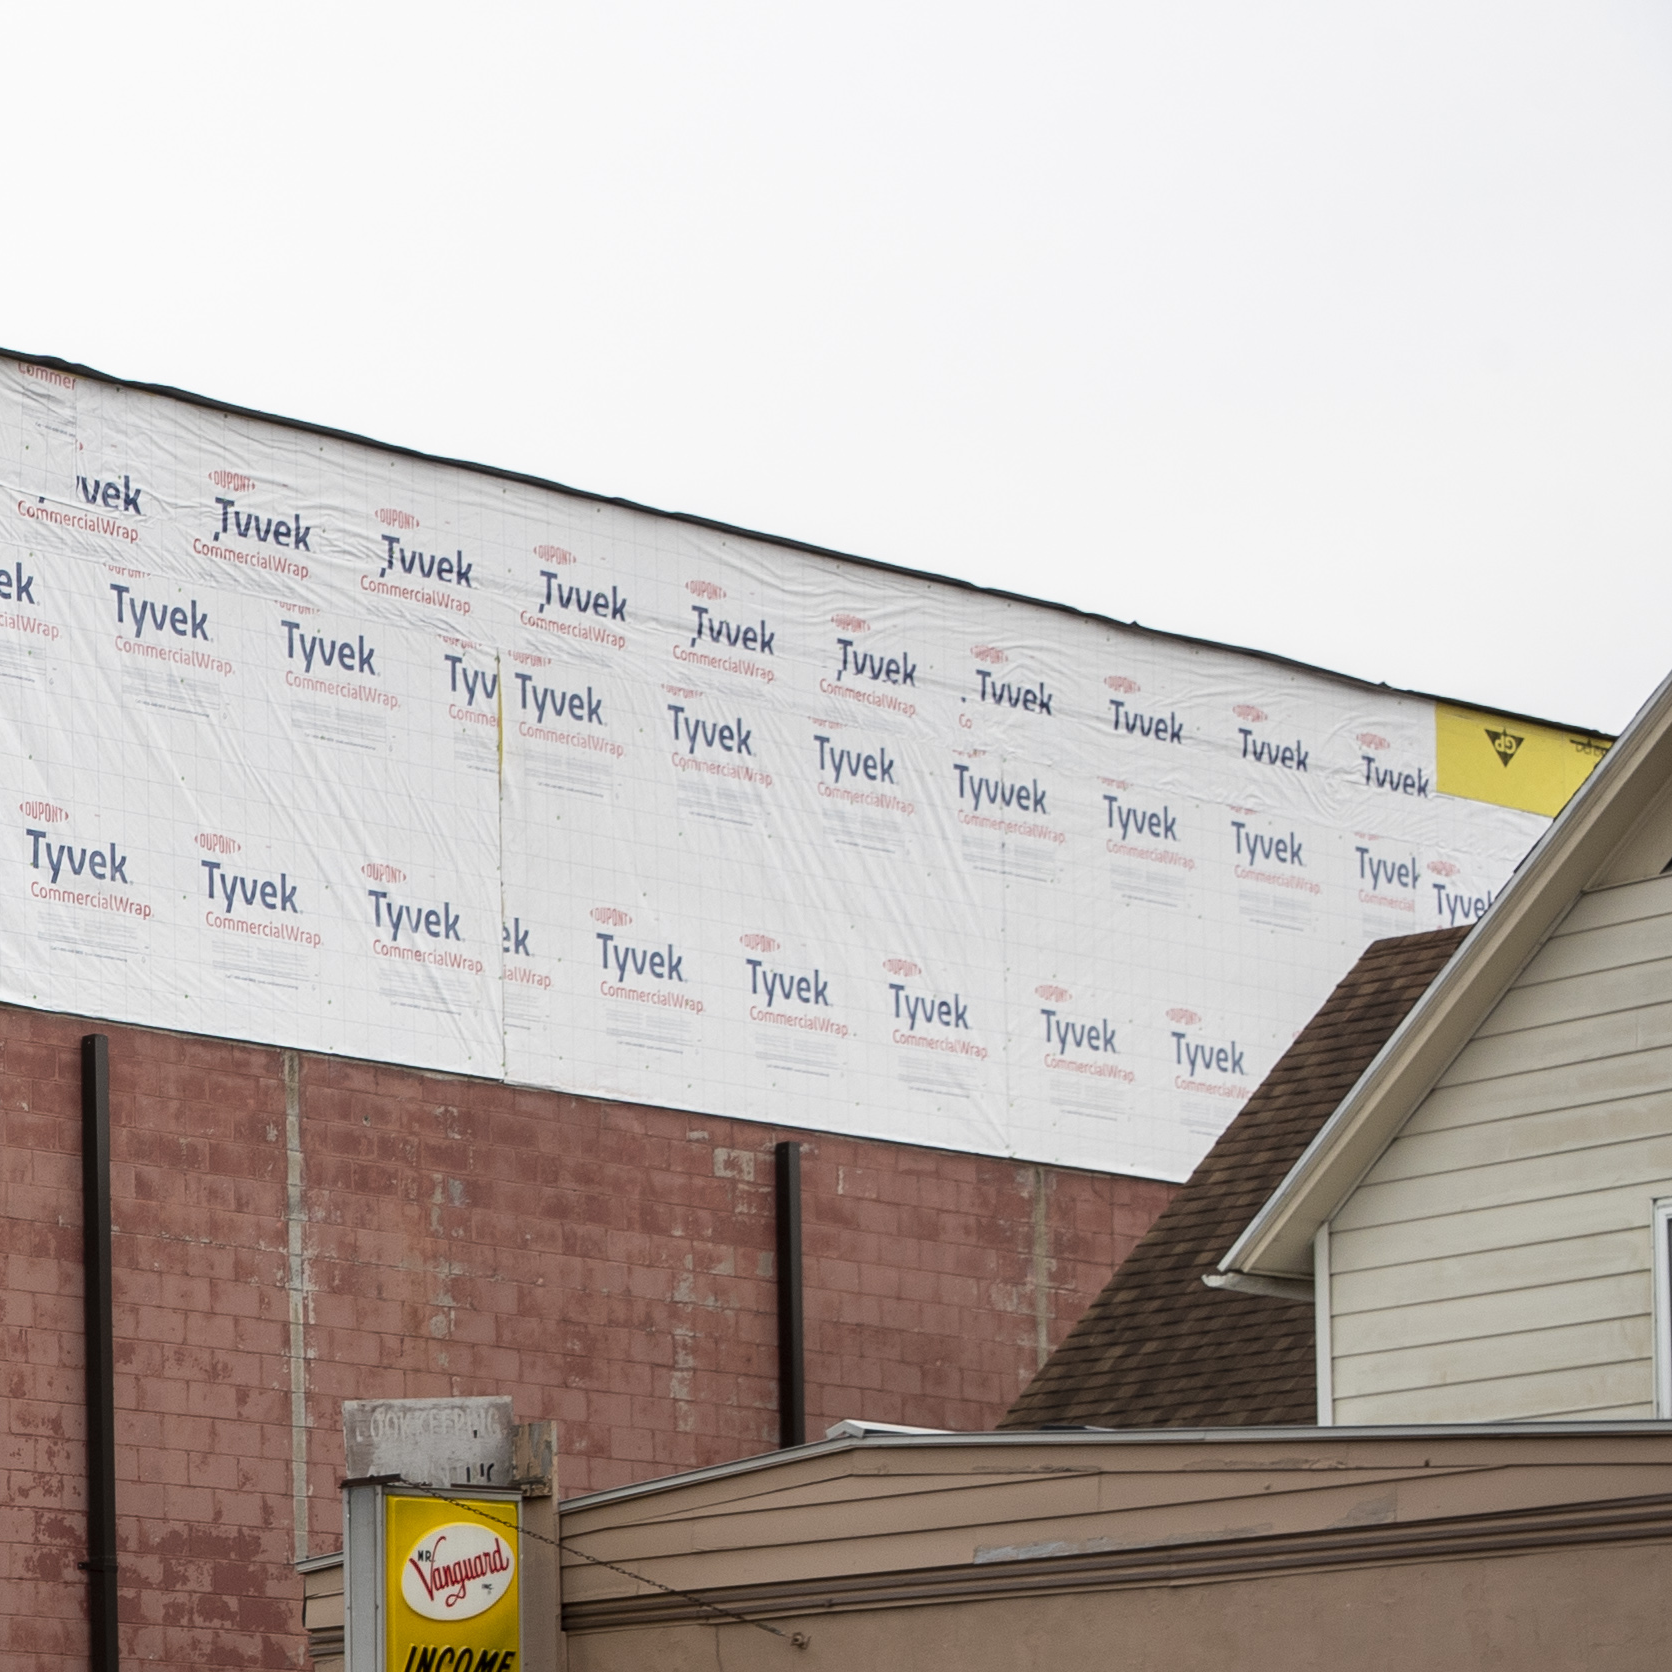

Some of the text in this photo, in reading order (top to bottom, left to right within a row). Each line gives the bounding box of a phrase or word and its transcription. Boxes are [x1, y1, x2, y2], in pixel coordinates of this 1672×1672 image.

[75, 474, 143, 515] vek
[111, 584, 208, 639] Tyvek
[282, 621, 375, 674] Tyvek
[515, 673, 602, 723] Tyvek
[668, 705, 751, 755] Tyvek
[814, 735, 893, 783] Tyvek
[1104, 795, 1175, 839] Tyvek
[27, 829, 127, 883] Tyvek
[1232, 822, 1301, 865] Tyvek
[202, 860, 297, 912] Tyvek
[369, 890, 460, 940] Tyvek
[597, 933, 682, 982] Tyvek
[747, 959, 828, 1006] Tyvek
[890, 984, 968, 1029] Tyvek
[1042, 1009, 1115, 1054] Tyvek
[1172, 1032, 1243, 1075] Tyvek
[409, 1536, 510, 1607] Vanguard
